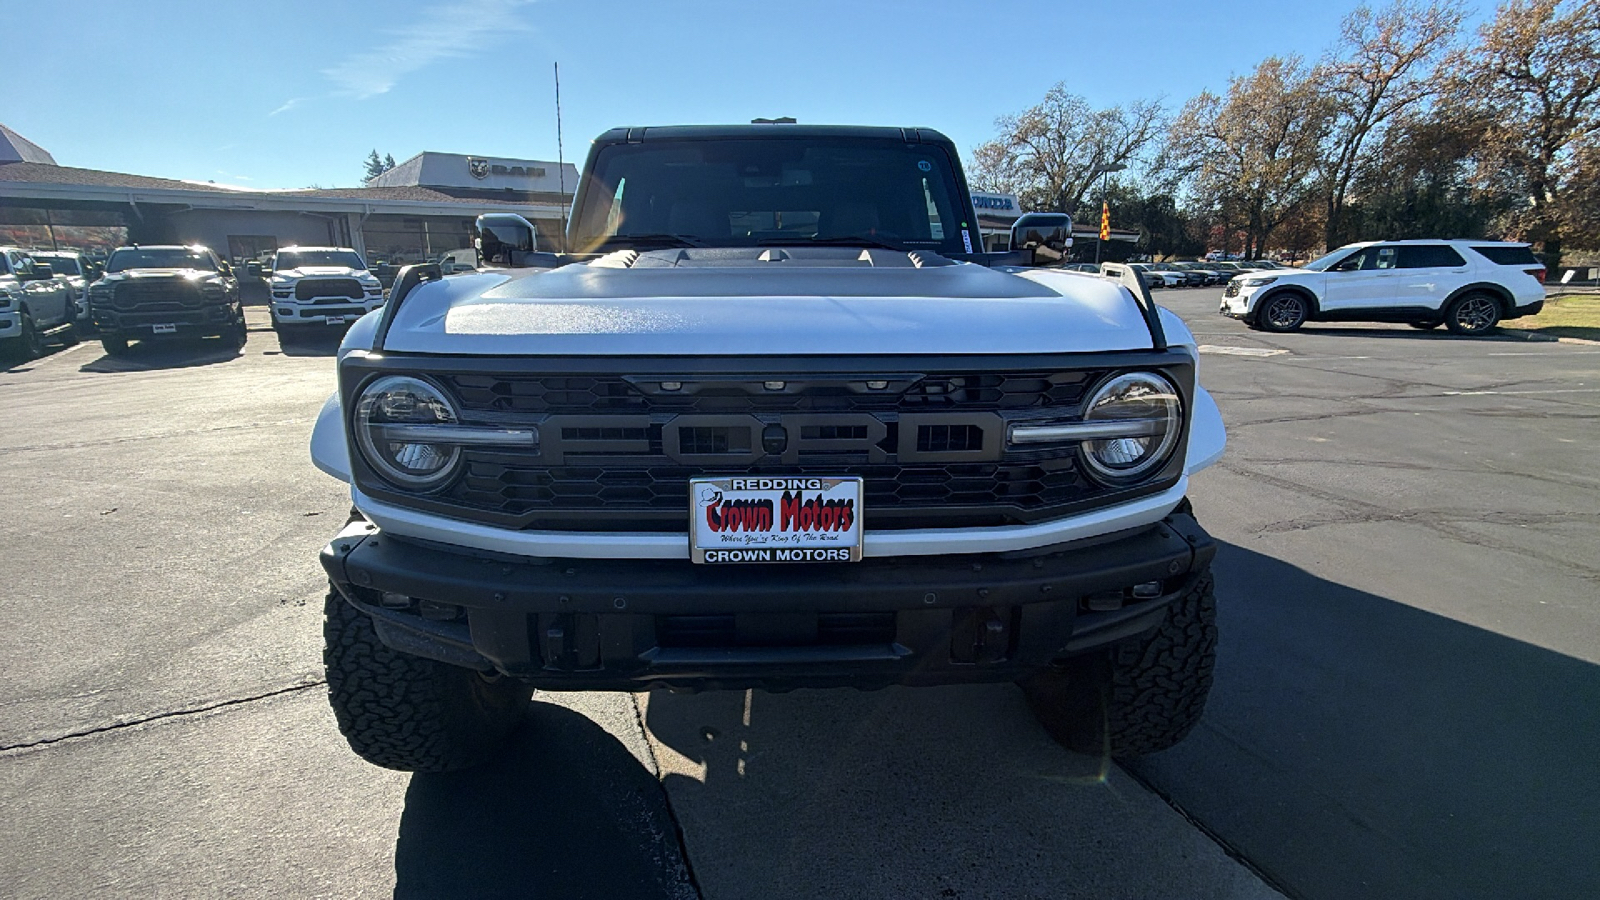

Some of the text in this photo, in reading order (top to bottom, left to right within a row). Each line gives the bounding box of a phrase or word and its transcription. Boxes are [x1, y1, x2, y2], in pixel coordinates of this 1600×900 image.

[971, 195, 1014, 210] ONDA
[539, 412, 1001, 466] FORD
[732, 479, 821, 490] REDDING
[706, 490, 855, 533] Crown Motors
[720, 534, 743, 543] Where
[771, 534, 789, 543] King
[791, 533, 801, 544] Of
[803, 533, 817, 541] The
[820, 533, 839, 541] Road
[705, 549, 850, 562] CROWN MOTORS
